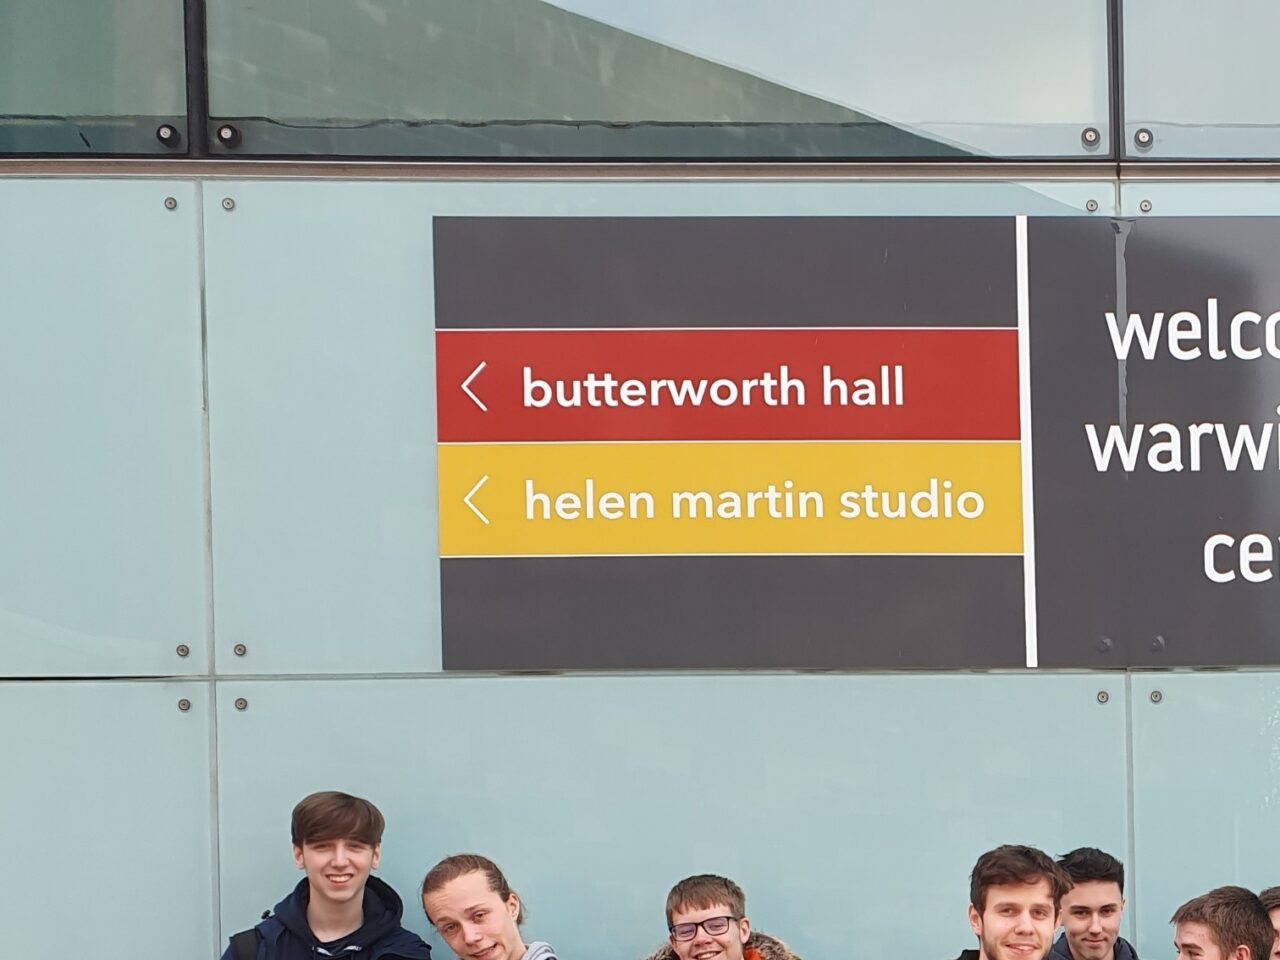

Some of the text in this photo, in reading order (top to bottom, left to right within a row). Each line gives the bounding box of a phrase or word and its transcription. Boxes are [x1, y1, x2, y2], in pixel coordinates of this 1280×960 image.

[523, 365, 904, 408] butterworth hall
[525, 479, 985, 520] helen martin studio
